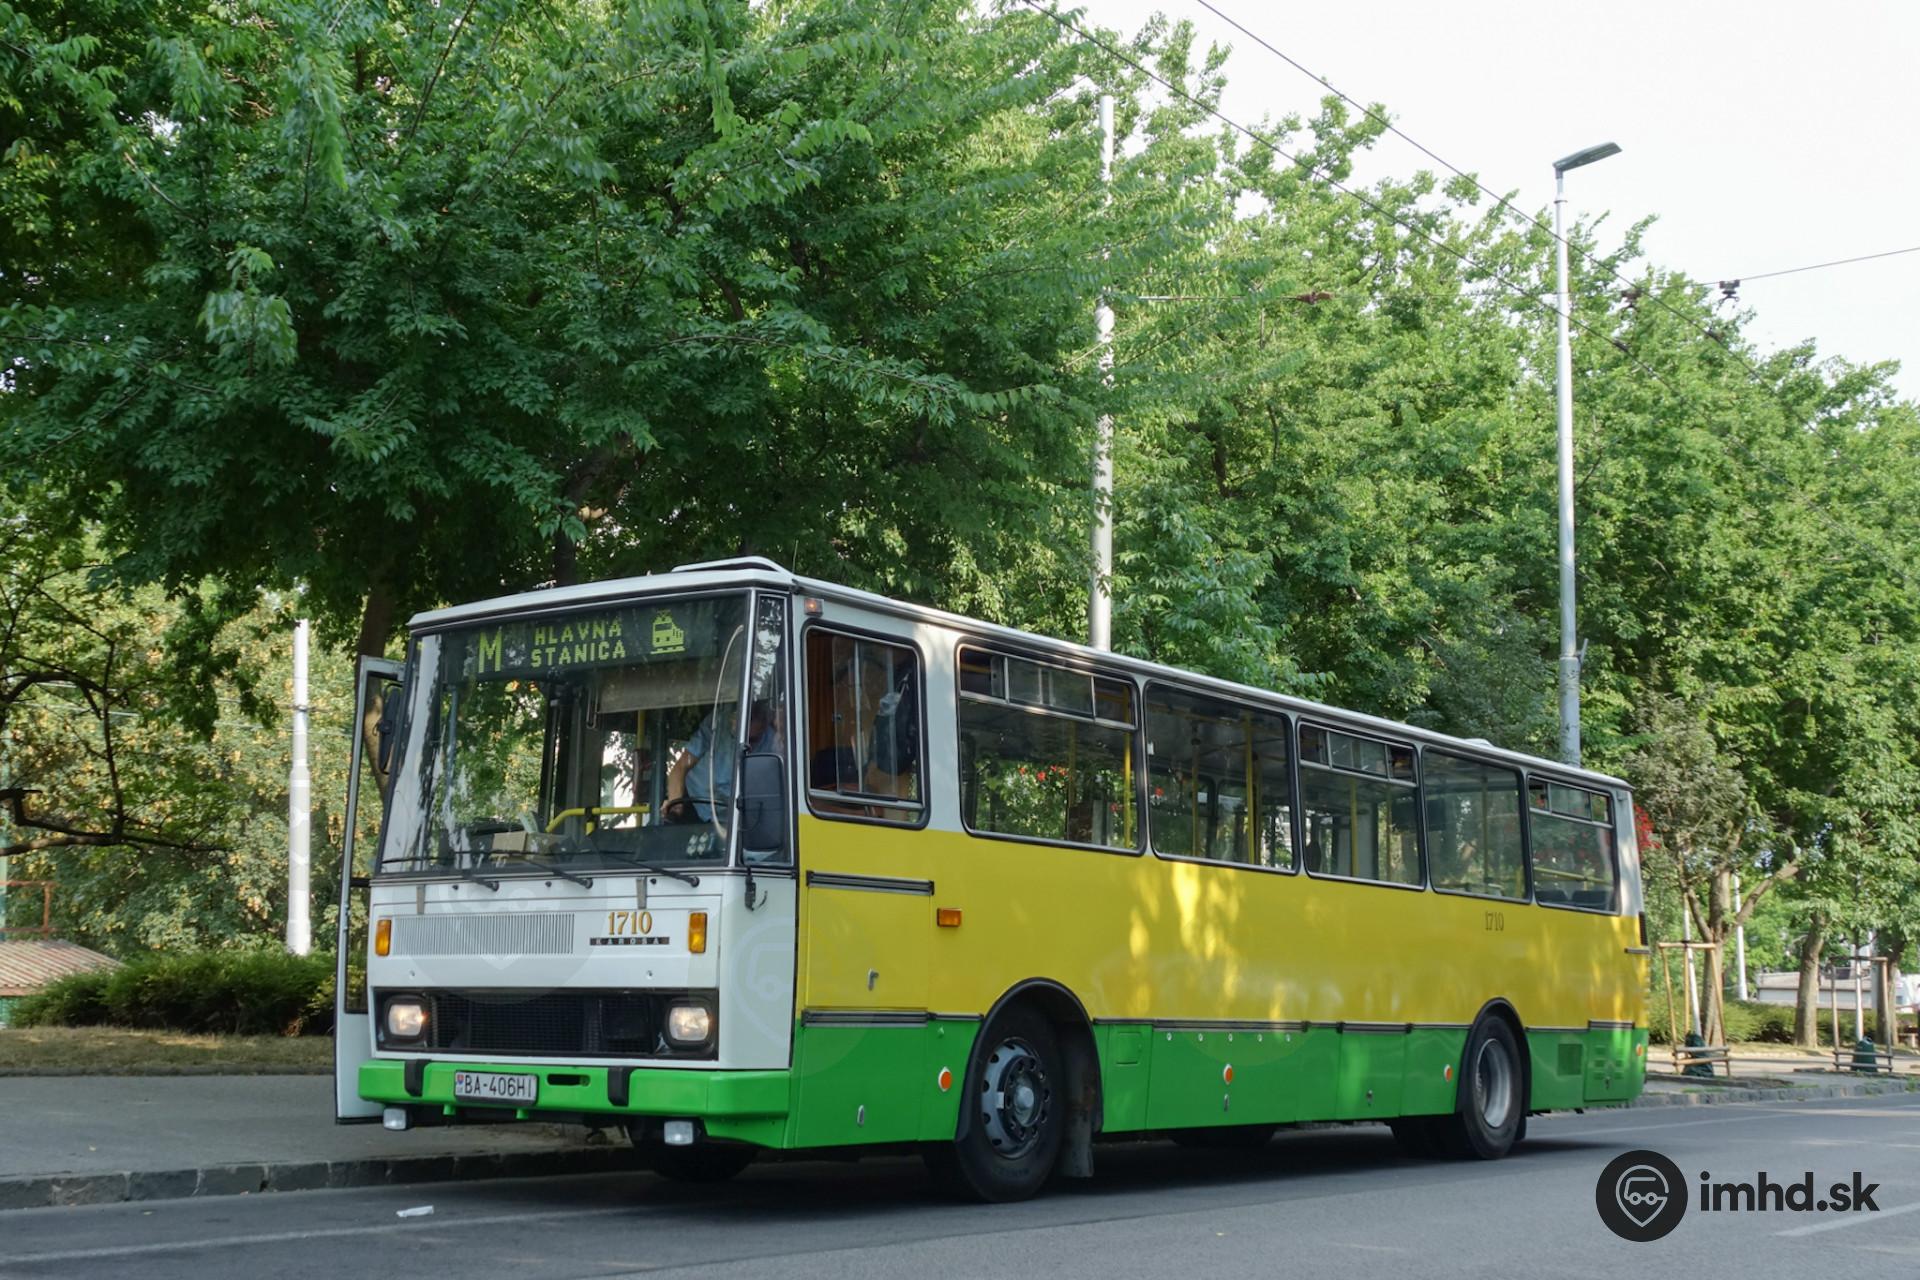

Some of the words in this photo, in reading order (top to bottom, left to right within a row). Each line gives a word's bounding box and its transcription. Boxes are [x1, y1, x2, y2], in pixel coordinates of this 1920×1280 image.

[477, 629, 502, 673] M
[531, 639, 626, 668] STANICA
[608, 911, 653, 935] 1710
[1485, 909, 1505, 932] 1710
[464, 1074, 532, 1098] BA-406HI
